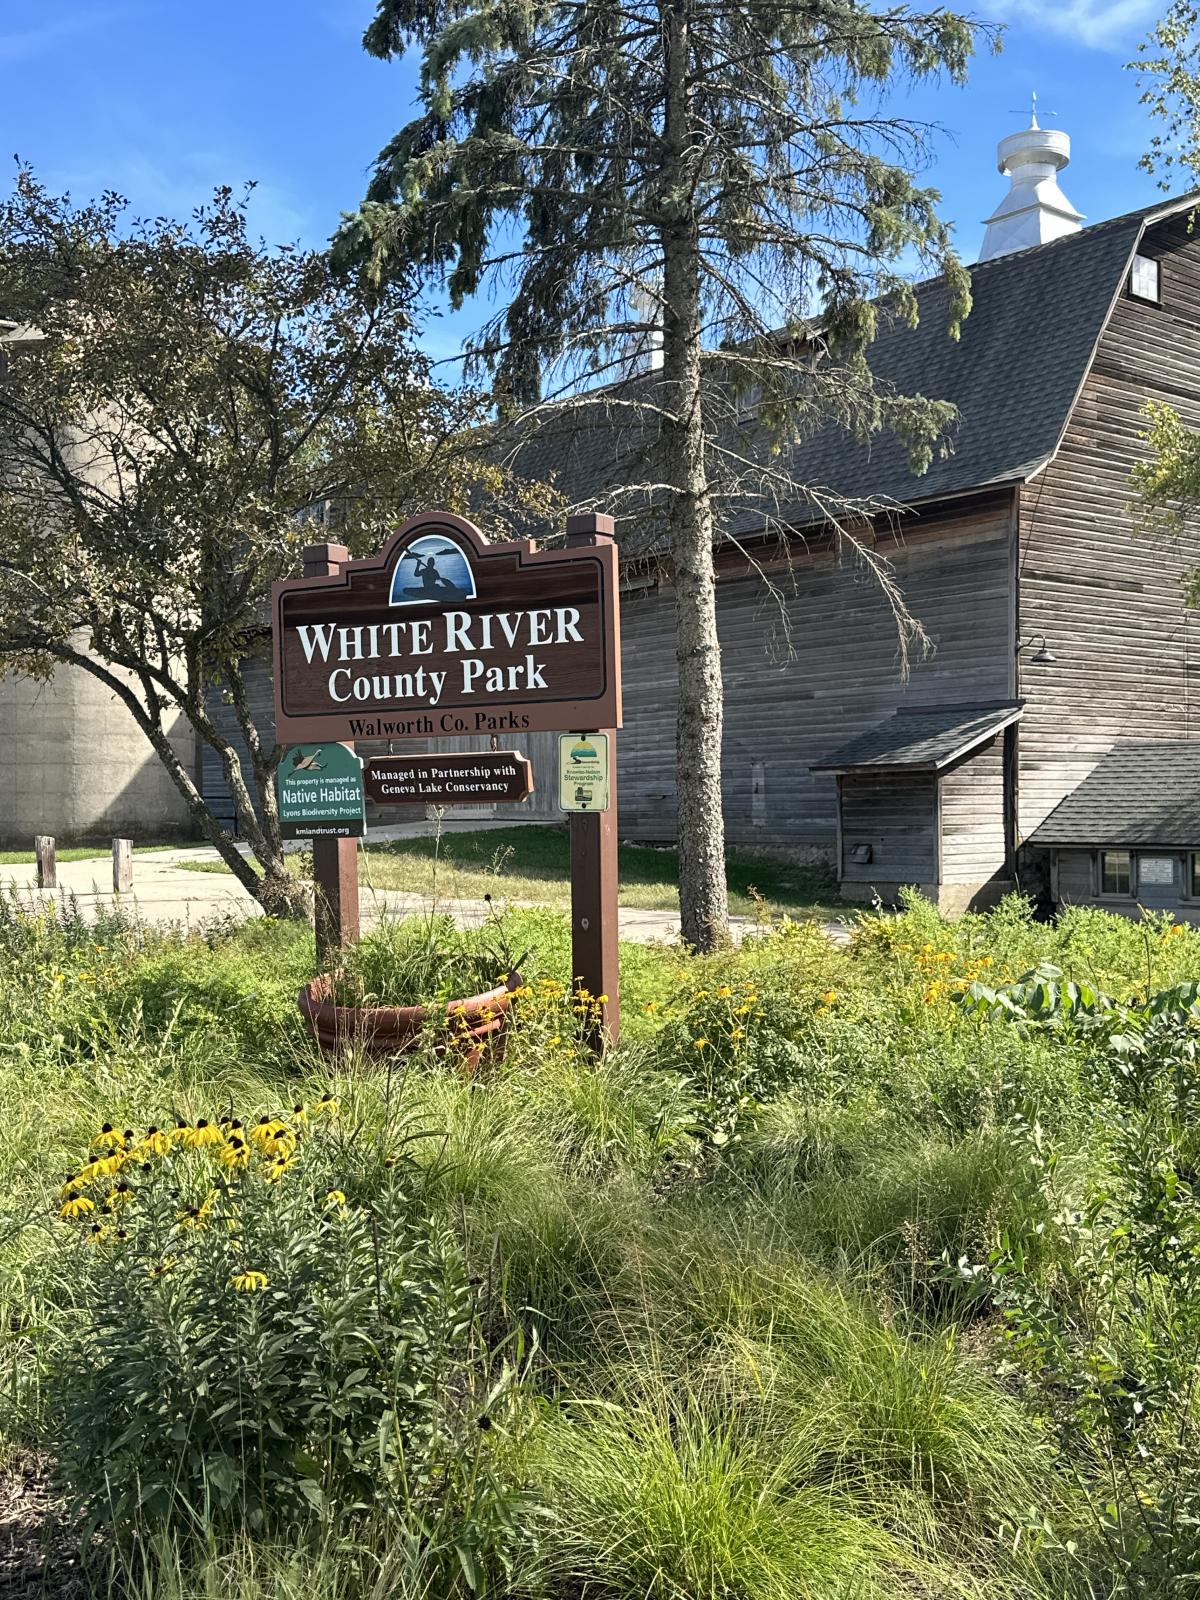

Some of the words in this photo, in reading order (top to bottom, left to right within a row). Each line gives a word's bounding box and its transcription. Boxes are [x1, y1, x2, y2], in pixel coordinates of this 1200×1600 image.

[296, 621, 433, 664] WHITE
[442, 608, 584, 652] RIVER
[329, 665, 447, 705] County
[460, 655, 548, 693] Park
[349, 716, 433, 736] Walworth
[440, 714, 468, 732] Co.
[475, 711, 529, 730] Parks
[371, 769, 415, 781] Managed
[417, 769, 428, 779] in
[431, 766, 491, 779] Partnership
[494, 765, 516, 776] with
[564, 774, 604, 782] Stewardship
[297, 778, 319, 787] property
[325, 776, 350, 785] managed
[381, 784, 415, 794] Geneva
[418, 782, 443, 793] Lake
[445, 782, 509, 793] Conservancy
[282, 788, 318, 804] Native
[320, 786, 361, 802] Habitat
[283, 809, 301, 819] Lyons
[302, 807, 338, 817] Biodiversity
[339, 807, 362, 816] Project
[295, 827, 350, 835] kmlandtrust.org
